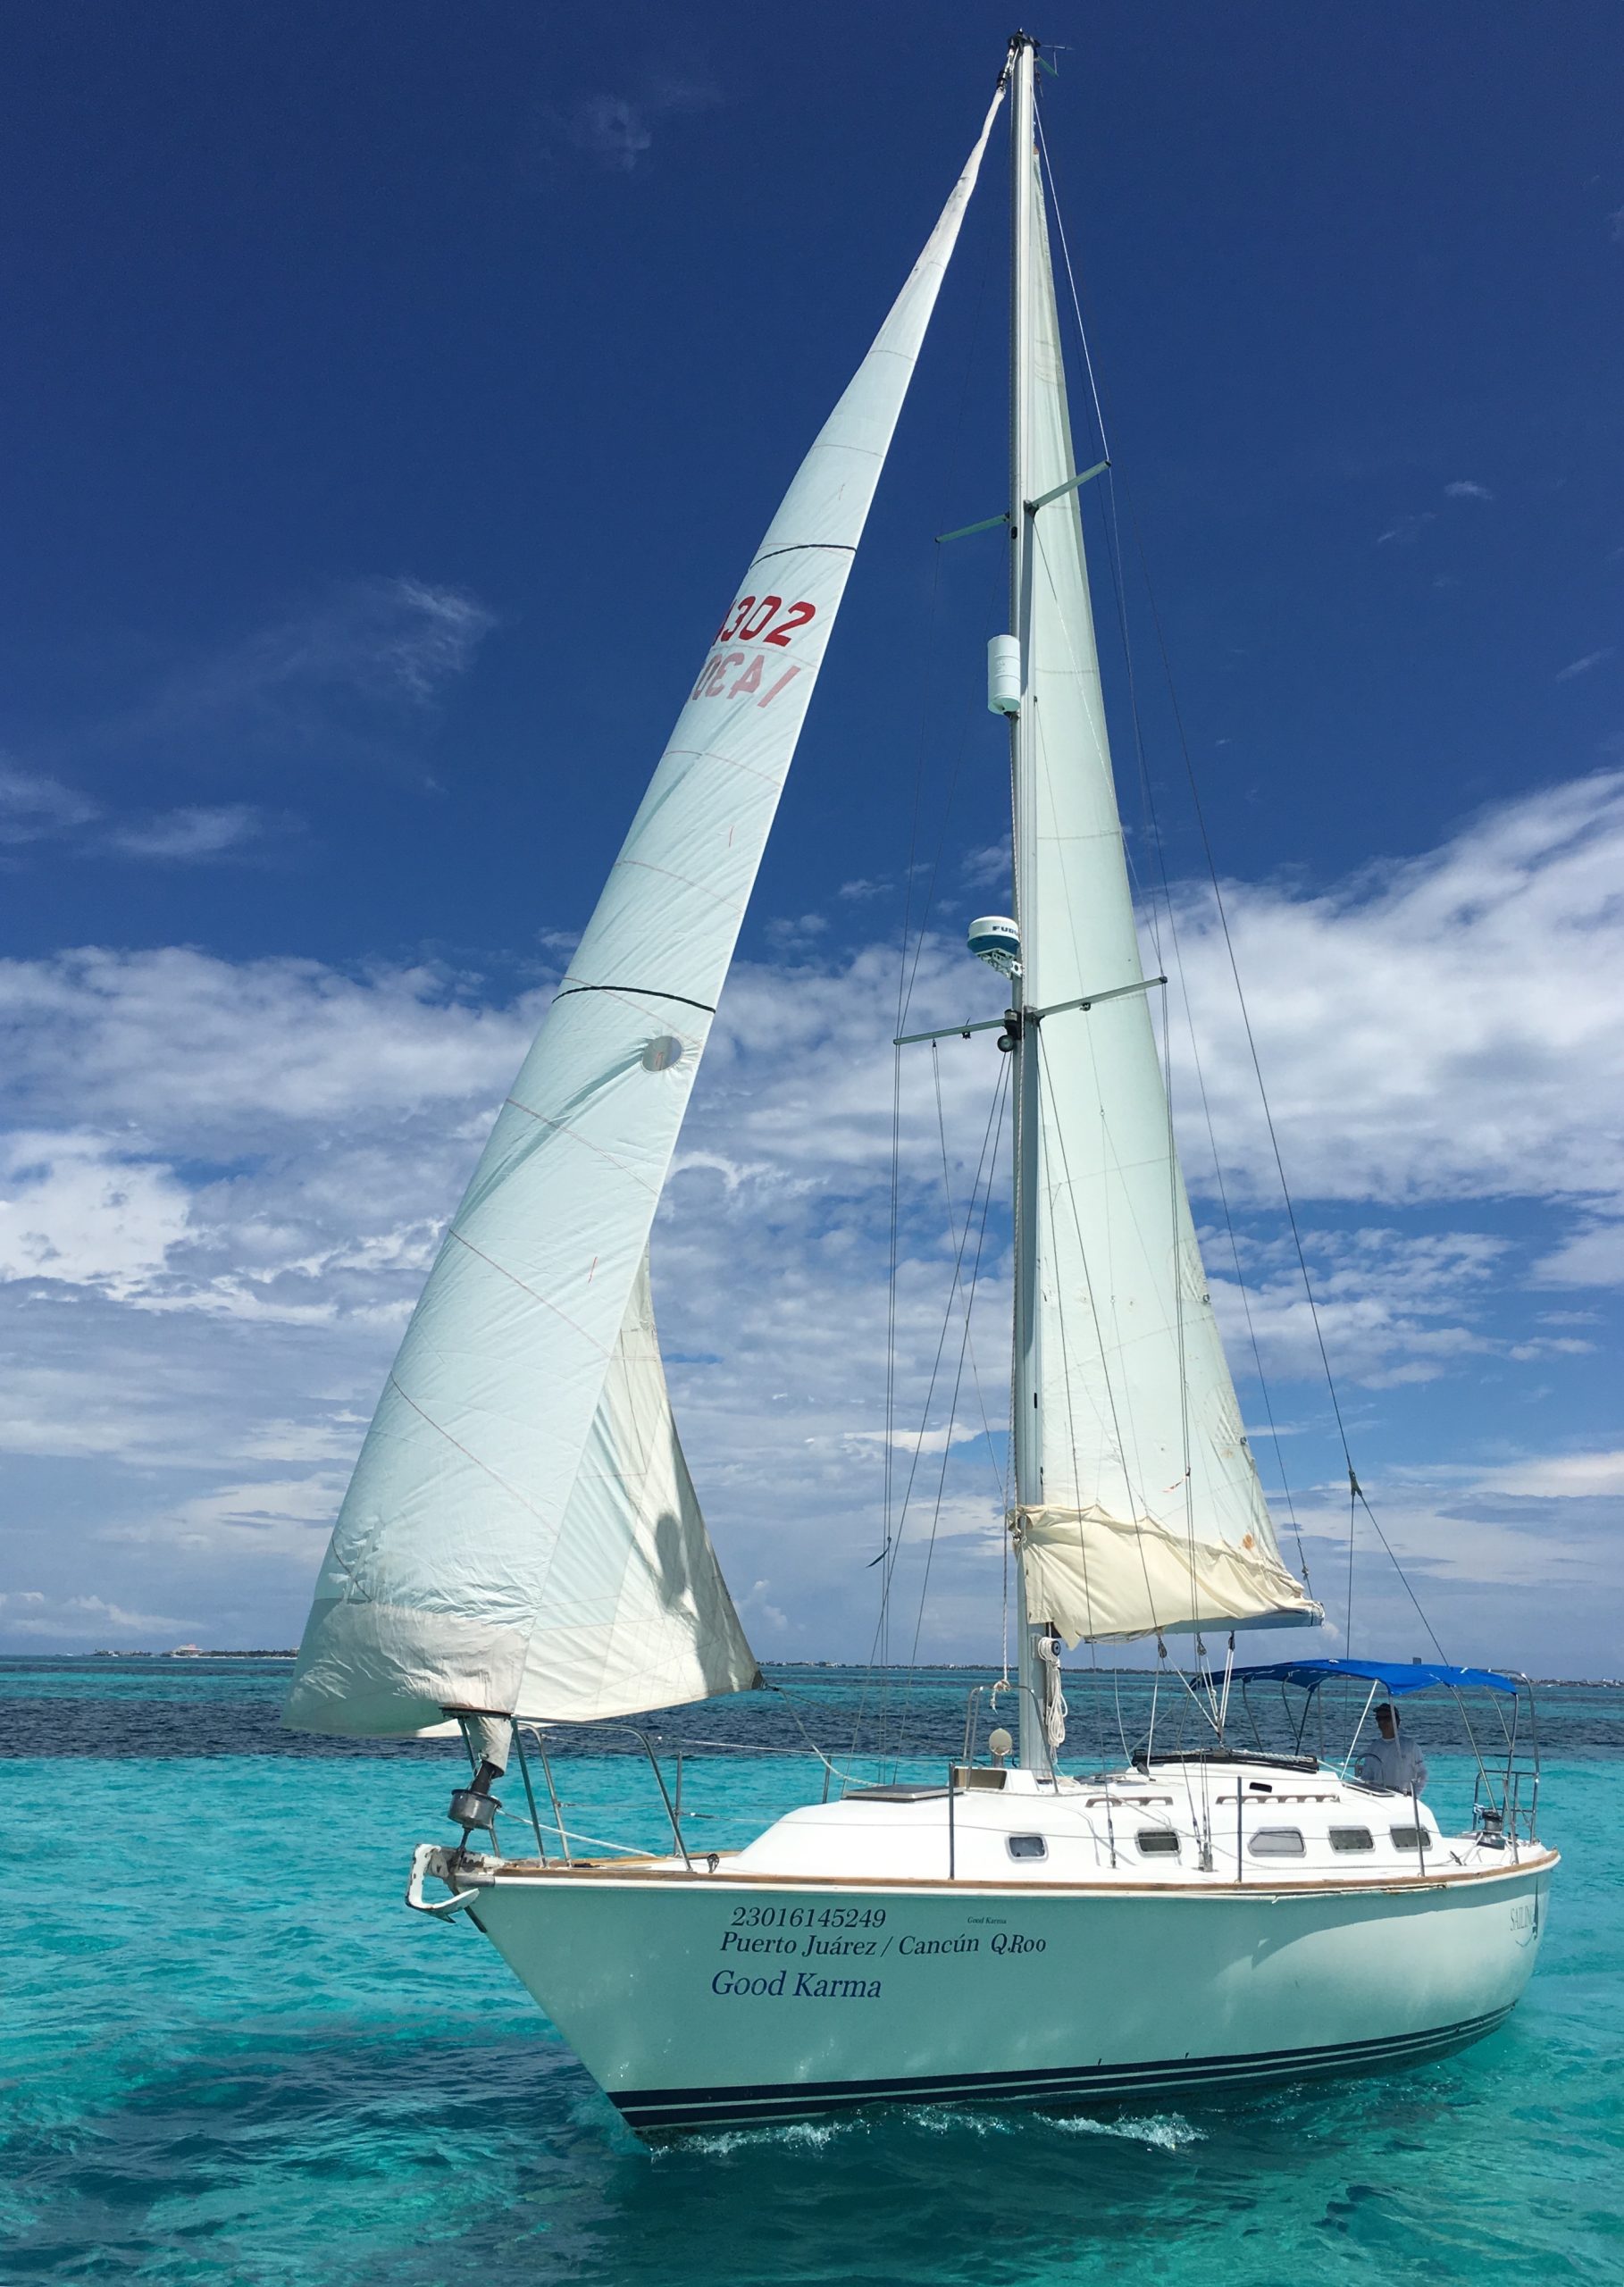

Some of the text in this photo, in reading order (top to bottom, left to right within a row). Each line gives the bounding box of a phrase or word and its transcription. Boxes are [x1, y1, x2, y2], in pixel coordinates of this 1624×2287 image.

[712, 595, 816, 647] 302
[731, 1906, 886, 1928] 23016145249
[720, 1931, 797, 1954] Puerto
[801, 1935, 877, 1957] Juárez
[880, 1936, 894, 1957] /
[899, 1933, 979, 1956] Cancún
[712, 1970, 882, 1998] Good Karma
